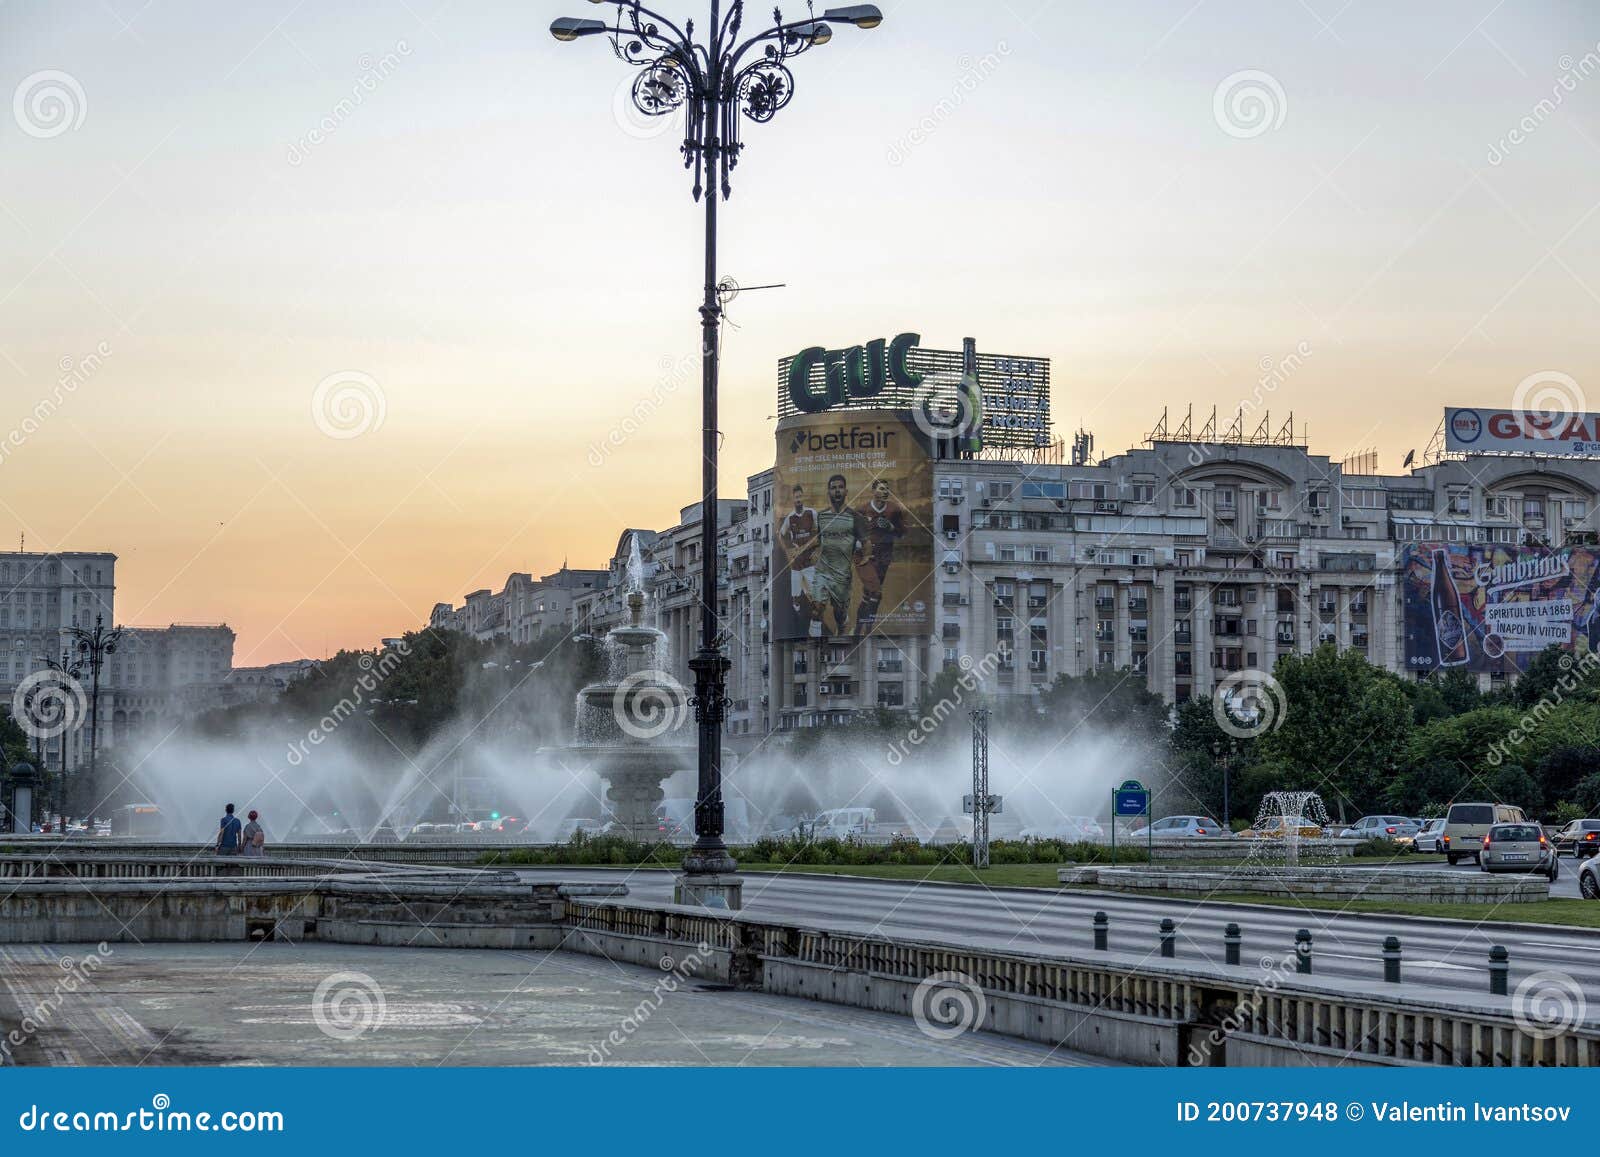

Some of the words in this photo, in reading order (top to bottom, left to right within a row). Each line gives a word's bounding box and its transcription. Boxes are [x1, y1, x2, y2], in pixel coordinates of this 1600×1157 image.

[1003, 378, 1034, 392] DIN
[1488, 413, 1600, 441] GRA
[808, 426, 896, 451] betfair
[1474, 552, 1570, 587] Gambrinus
[1489, 607, 1524, 620] SPIRITUL
[1526, 606, 1536, 617] DE
[1538, 606, 1548, 616] LA
[1549, 604, 1571, 616] 1869
[1496, 620, 1526, 633] ÎNAPOI
[1527, 622, 1537, 636] ÎN
[1540, 625, 1567, 638] VIITOR
